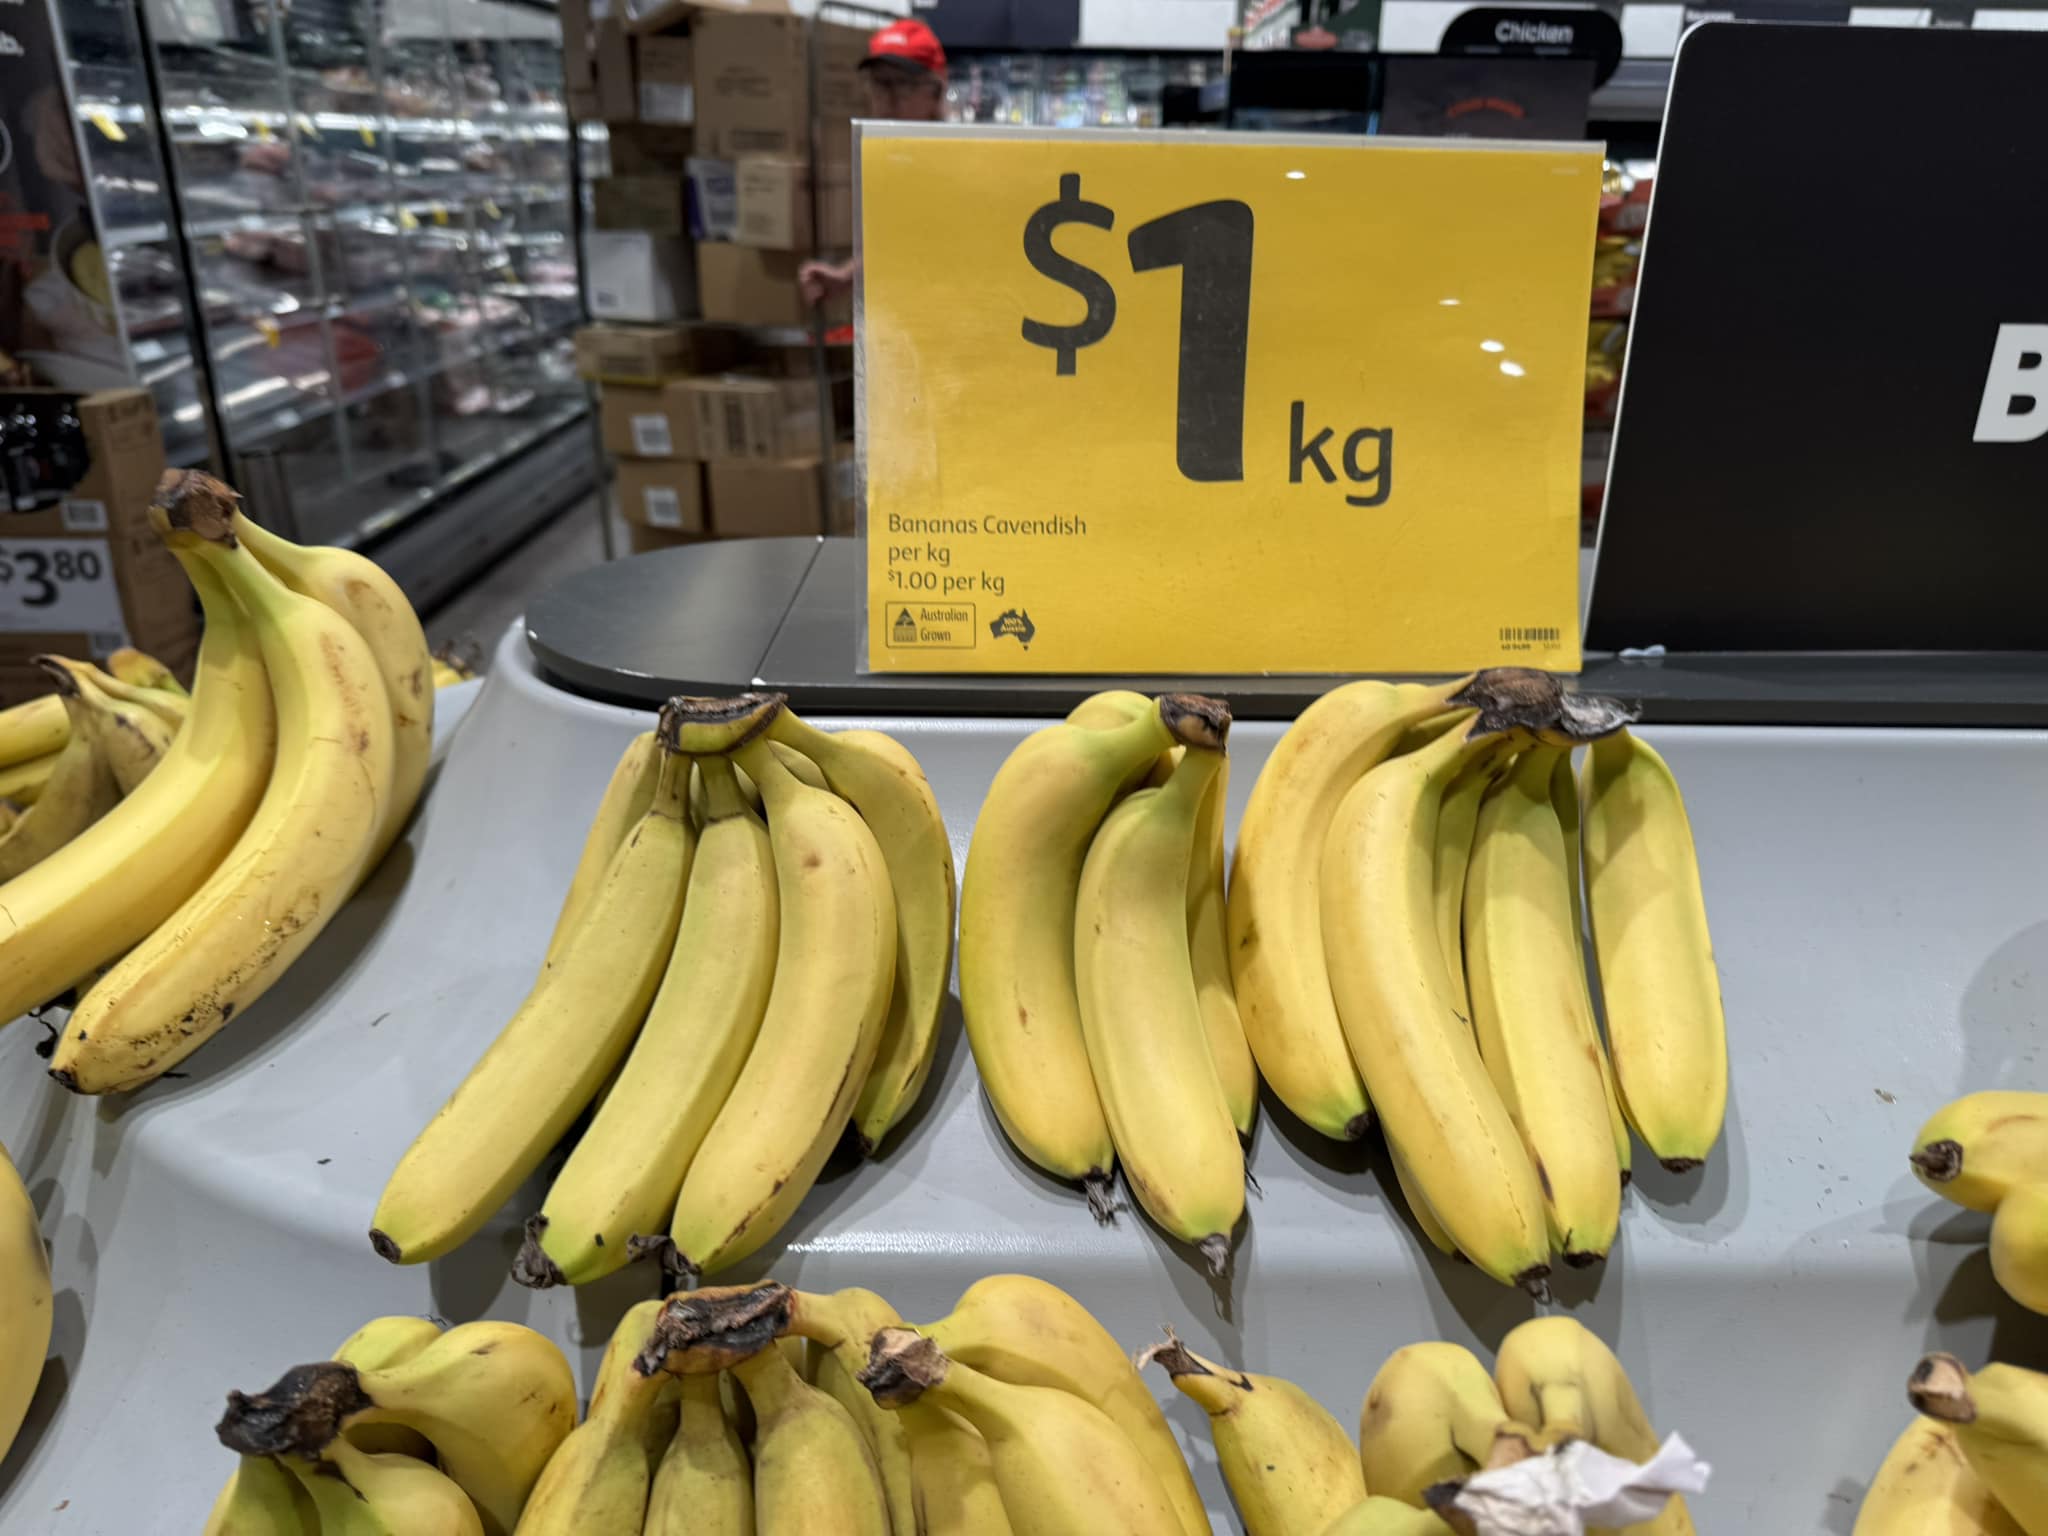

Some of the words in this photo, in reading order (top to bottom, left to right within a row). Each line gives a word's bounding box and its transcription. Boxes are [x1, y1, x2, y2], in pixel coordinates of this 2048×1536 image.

[1495, 20, 1574, 44] Chicken
[1021, 173, 1255, 482] $1
[1972, 323, 2048, 442] B
[1289, 400, 1394, 506] kg
[888, 513, 978, 534] Bananas
[983, 515, 1087, 536] Cavendish
[888, 546, 922, 566] per
[927, 541, 951, 567] kg
[888, 569, 937, 590] $1.00
[943, 576, 976, 596] per
[982, 570, 1005, 596] kg
[920, 607, 968, 622] Australian
[920, 628, 951, 642] Grown
